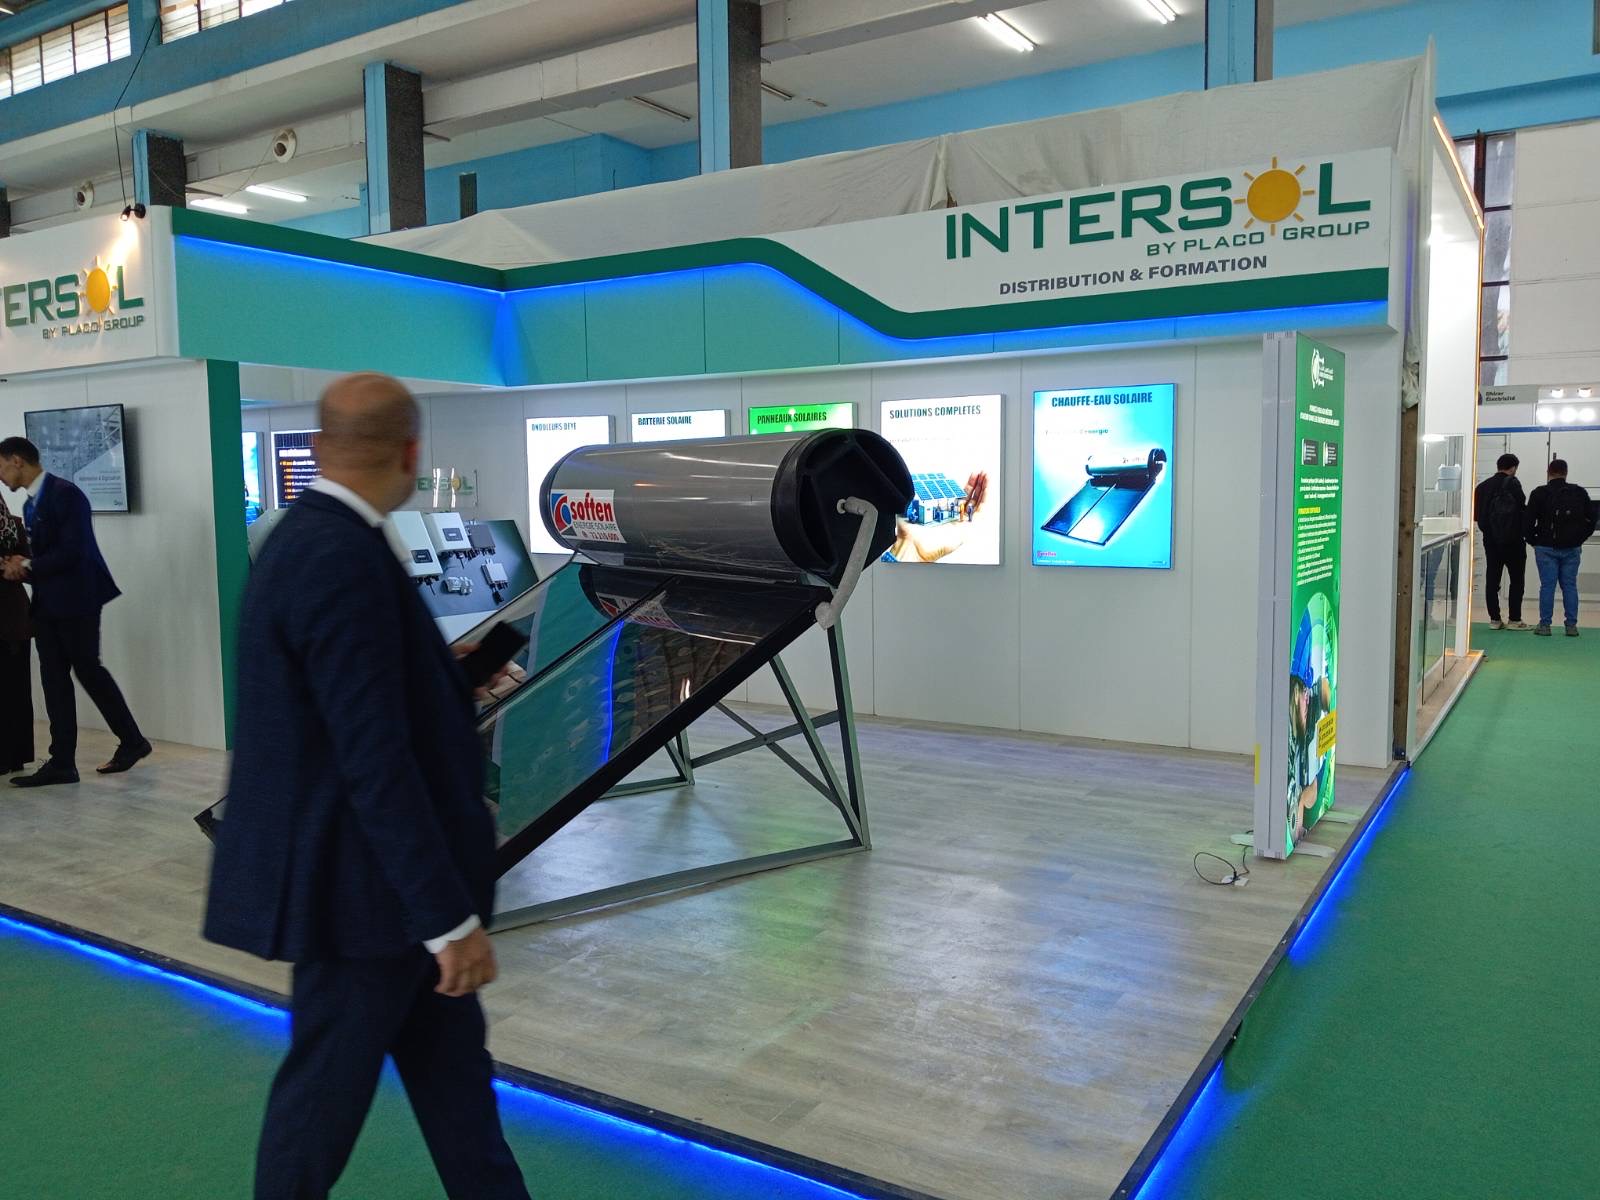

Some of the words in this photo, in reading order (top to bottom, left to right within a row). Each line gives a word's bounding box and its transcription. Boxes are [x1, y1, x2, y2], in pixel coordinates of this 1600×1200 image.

[1147, 242, 1176, 256] BY
[1184, 231, 1265, 252] PLACO
[1283, 221, 1371, 241] GROUP
[999, 270, 1125, 295] DISTRIBUTION
[1129, 268, 1143, 281] &
[1148, 255, 1267, 279] FORMATION
[0, 265, 144, 328] ERSOL
[42, 328, 56, 340] BY
[62, 321, 99, 336] PLACO
[104, 315, 144, 331] GROUP
[889, 408, 933, 419] SOLUTIONS
[934, 404, 981, 416] COMPLETES
[1052, 394, 1111, 407] CHAUFFE-EAU
[1113, 391, 1152, 404] SOLAIRE
[637, 416, 665, 425] BATTERIE
[666, 415, 692, 424] SOLAIRE
[757, 413, 792, 424] PANNEAUX
[794, 411, 827, 422] SOLAIRES
[570, 492, 614, 522] soften
